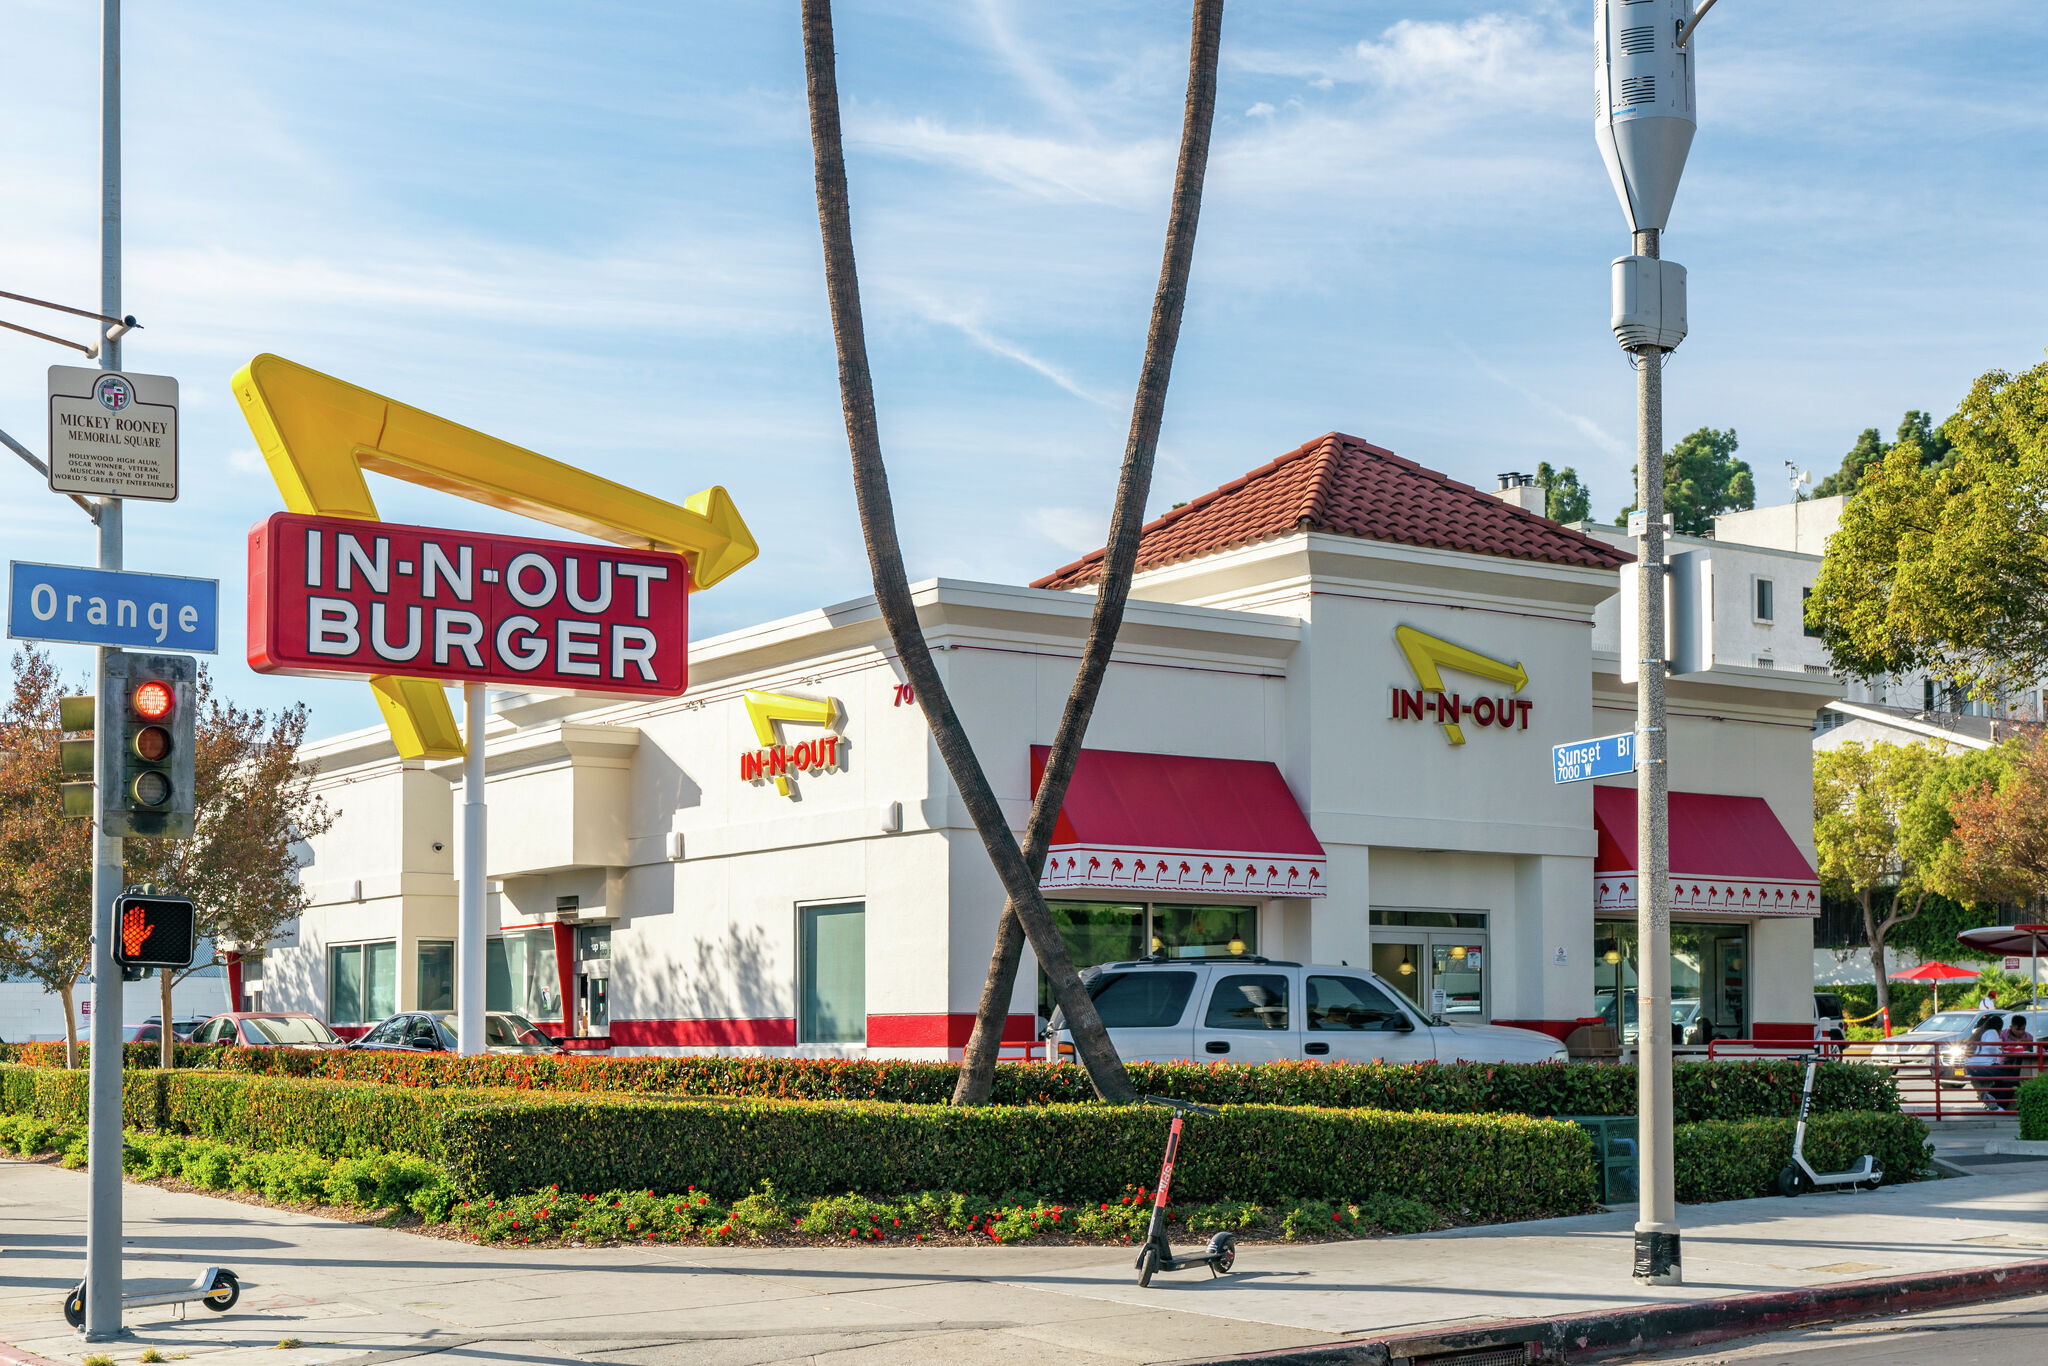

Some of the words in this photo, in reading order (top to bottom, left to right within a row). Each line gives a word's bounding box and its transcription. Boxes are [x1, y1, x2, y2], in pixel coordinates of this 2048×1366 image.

[60, 413, 111, 429] MICKEY
[116, 418, 168, 435] ROONEY
[68, 430, 121, 445] MEMORIAL
[124, 435, 161, 448] SQUARE
[68, 453, 114, 462] HOLLYWOOD
[68, 460, 92, 468] OSCAR
[95, 462, 125, 471] WINNER,
[128, 465, 161, 474] VETERAN,
[54, 473, 88, 482] WORLD'S
[90, 476, 123, 485] GREATEST
[126, 480, 174, 489] ENTERTAINERS
[69, 468, 105, 476] MUSICIAN
[31, 583, 199, 644] Orange
[307, 595, 660, 684] BURGER
[1392, 687, 1533, 730] IN-N-OUT
[740, 735, 839, 782] IN-N-OUT
[1557, 742, 1601, 768] Sunset
[1617, 736, 1630, 757] Bl
[1557, 764, 1580, 780] 7000
[1584, 762, 1592, 776] W
